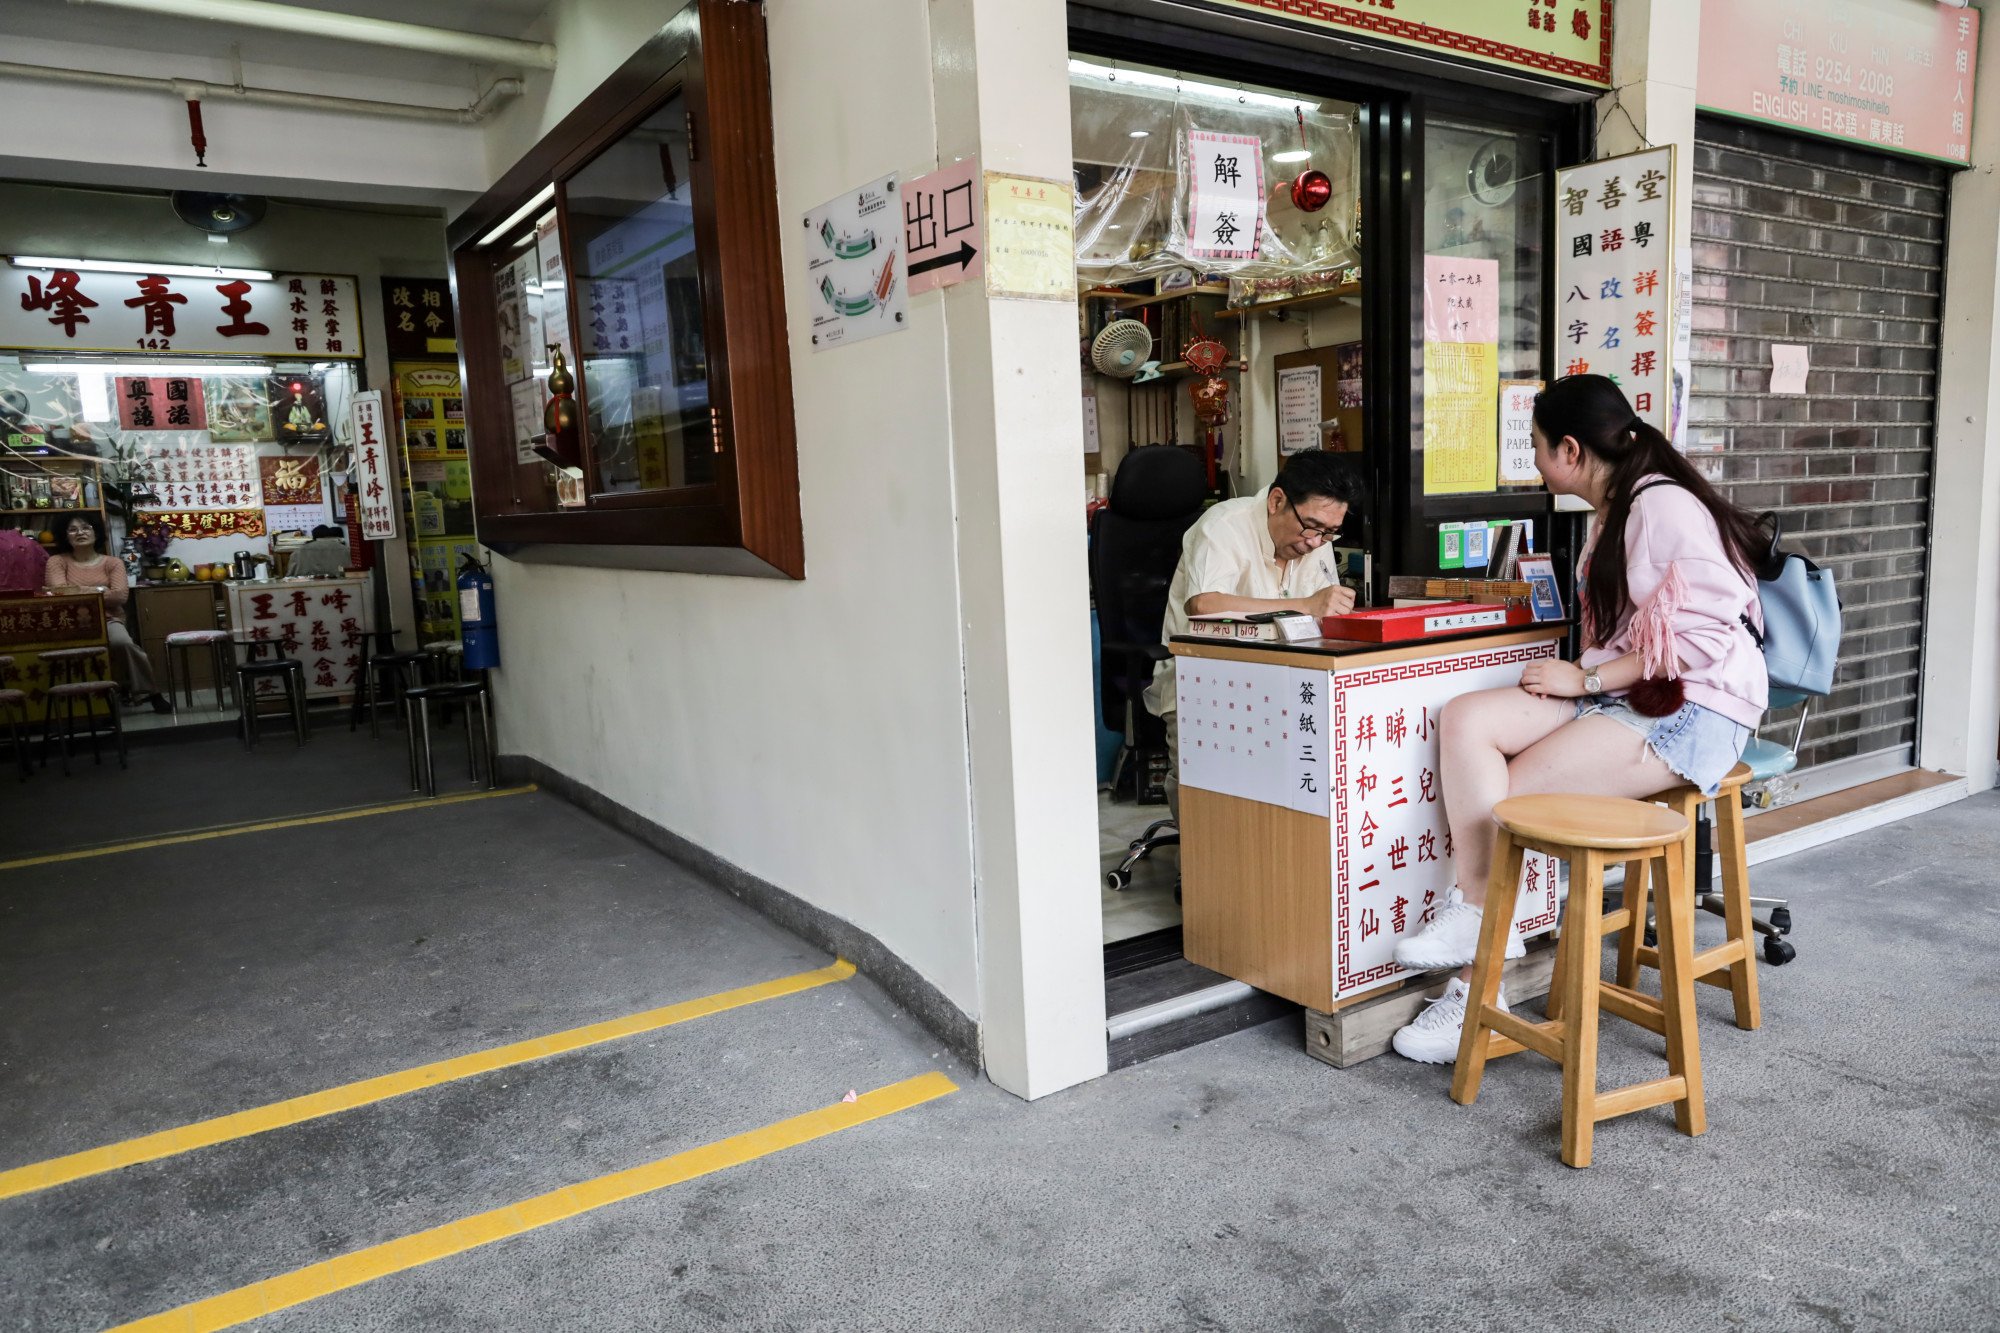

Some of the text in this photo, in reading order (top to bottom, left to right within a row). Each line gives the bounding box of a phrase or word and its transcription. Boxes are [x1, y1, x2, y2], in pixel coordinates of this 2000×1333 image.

[1783, 18, 1803, 41] CHI
[1828, 32, 1849, 55] KIU
[1871, 46, 1890, 66] HIN
[1776, 43, 1894, 98] 電話 9254 2008
[1779, 75, 1798, 97] 予約
[1802, 81, 1825, 100] LINE:
[1952, 17, 1969, 135] 手相人相
[1752, 91, 1905, 145] ENGLISH 日本語 廣東話
[906, 179, 974, 253] 出口
[1213, 152, 1242, 247] 解簽
[1562, 169, 1666, 217] 智善堂
[1439, 272, 1483, 287] 二零一九年
[137, 337, 171, 349] 142
[127, 379, 155, 427] 粵語
[167, 379, 190, 426] 國語
[275, 460, 307, 490] 福
[360, 422, 384, 505] 王青峰
[251, 588, 352, 620] 王青峰
[1299, 681, 1317, 794] 簽紙三元
[1354, 714, 1380, 943] 拜和合二仙
[1386, 707, 1409, 935] 睇三世書
